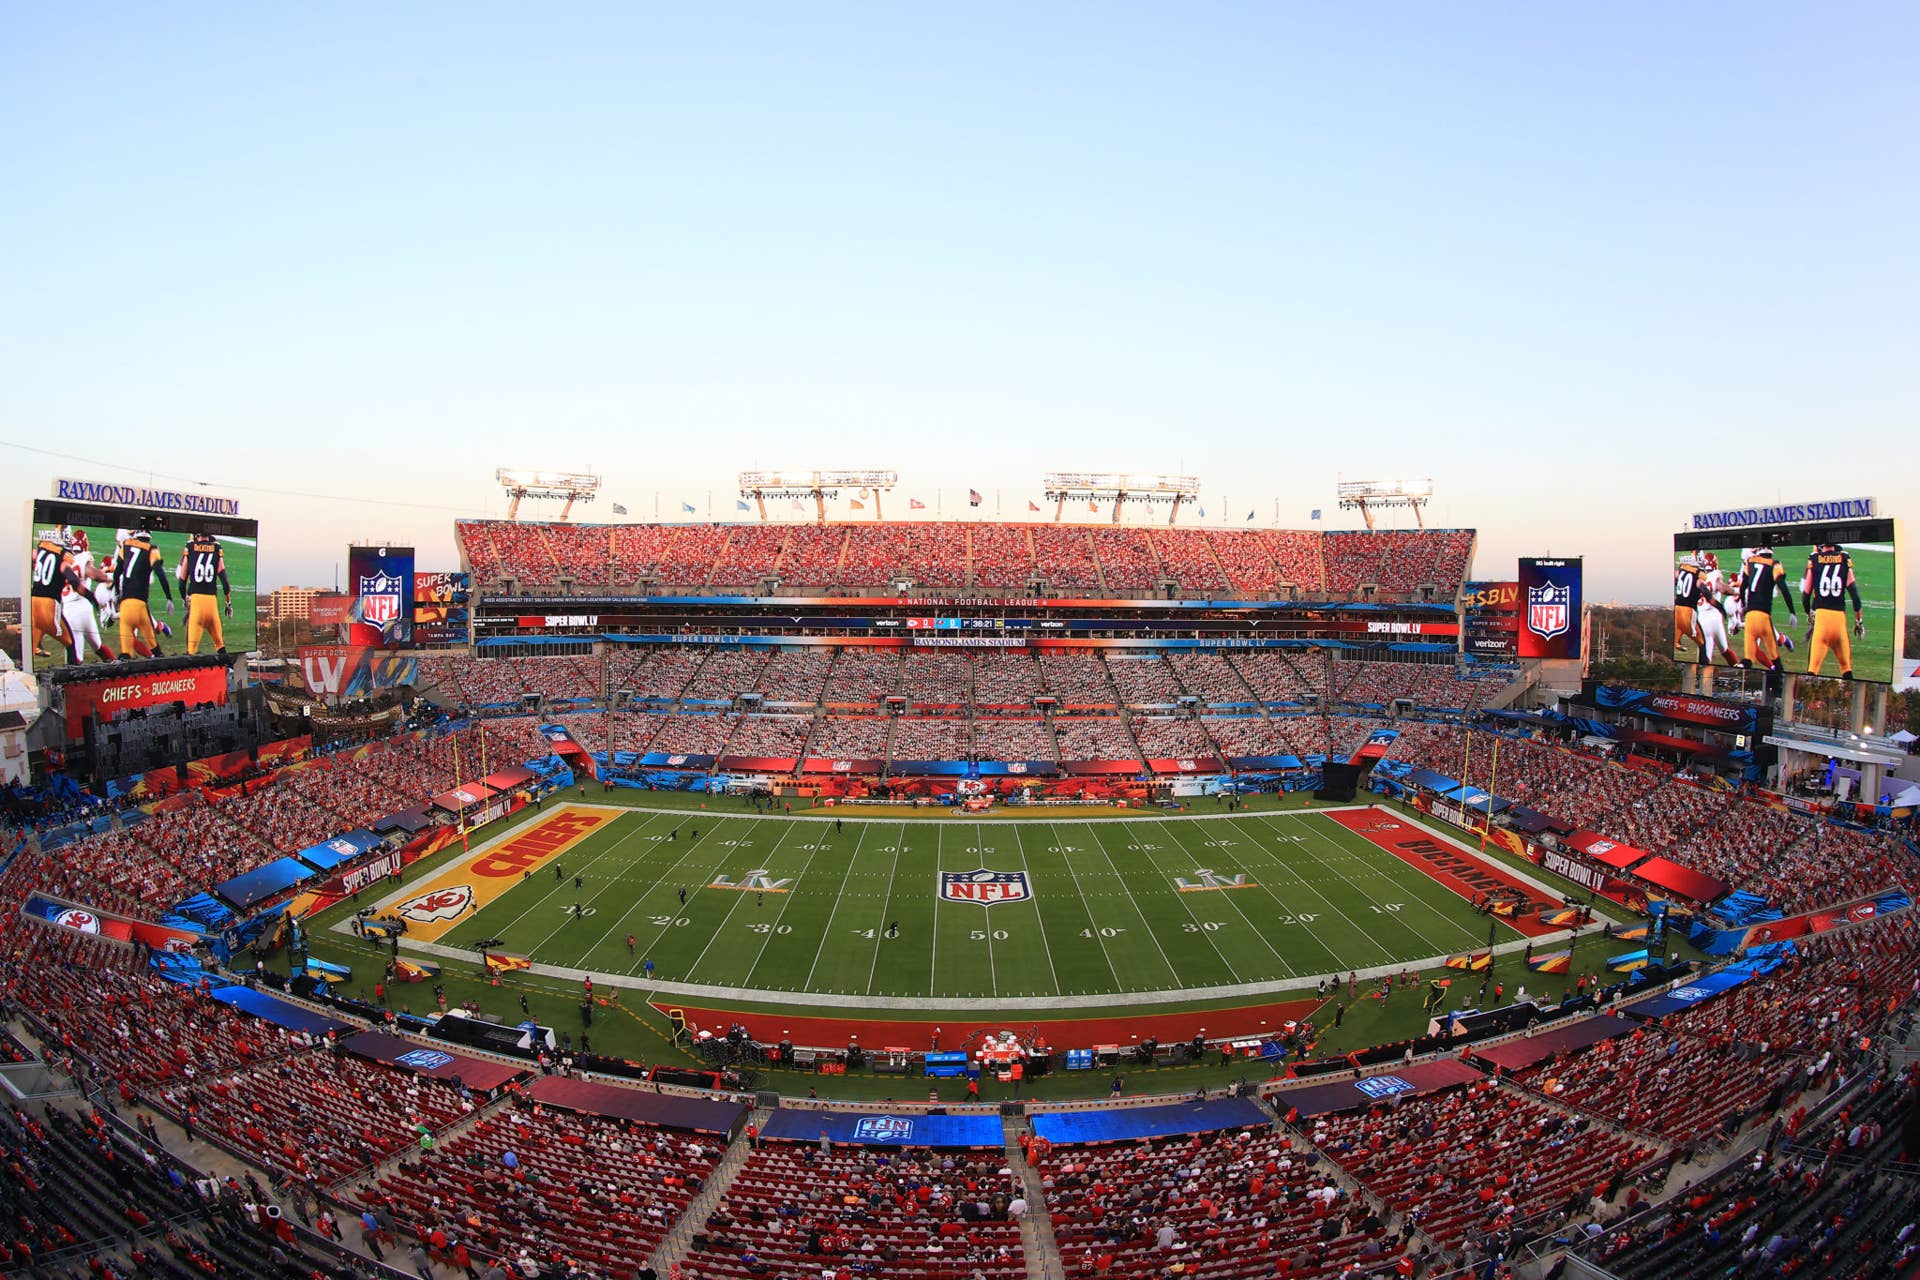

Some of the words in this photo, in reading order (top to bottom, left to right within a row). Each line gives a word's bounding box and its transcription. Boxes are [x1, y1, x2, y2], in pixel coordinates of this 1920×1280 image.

[58, 479, 134, 505] RAYMOND
[137, 489, 182, 509] JAMES
[185, 493, 239, 515] STADIUM
[1693, 509, 1758, 529] RAYMOND
[1760, 505, 1804, 524] JAMES
[1807, 499, 1871, 518] STADIUM
[378, 548, 386, 557] G
[126, 546, 141, 578] 7
[194, 553, 215, 583] 66
[416, 573, 452, 589] SUPER
[1750, 563, 1765, 592] 7
[1819, 565, 1842, 597] 66
[436, 582, 465, 597] BOWL
[1466, 586, 1519, 607] #SBLV
[364, 595, 399, 622] NFL
[545, 616, 568, 626] SUPER
[569, 616, 589, 626] BOWL
[590, 615, 598, 626] LV
[1532, 605, 1565, 631] NFL
[1367, 622, 1390, 633] SUPER
[1391, 622, 1411, 633] BOWL
[1412, 623, 1421, 633] LV
[916, 639, 957, 647] RAYMOND
[1200, 639, 1227, 647] SUPER
[1475, 638, 1505, 649] verizon
[305, 657, 347, 693] LV
[102, 684, 142, 703] CHIEFS
[151, 677, 196, 696] BUCCANEERS
[1652, 697, 1679, 710] CHIEFS
[1686, 702, 1740, 721] BUCCANEERS
[1431, 801, 1449, 821] SUPER
[1448, 808, 1465, 827] BOWL
[470, 812, 602, 878] CHIEFS
[343, 866, 370, 894] SUPER
[370, 859, 391, 882] BOWL
[392, 851, 400, 868] LV
[1544, 850, 1570, 877] SUPER
[1569, 861, 1591, 886] BOWL
[1592, 867, 1604, 891] LV
[950, 883, 1021, 901] NFL
[412, 891, 466, 913] KC
[1369, 903, 1402, 914] 10
[65, 911, 93, 929] KC
[652, 916, 691, 927] 20
[1183, 921, 1220, 933] 30
[1279, 913, 1317, 925] 20
[753, 923, 793, 935] 30
[970, 930, 1009, 941] 50
[1080, 927, 1119, 939] 40
[865, 1120, 909, 1131] NFL
